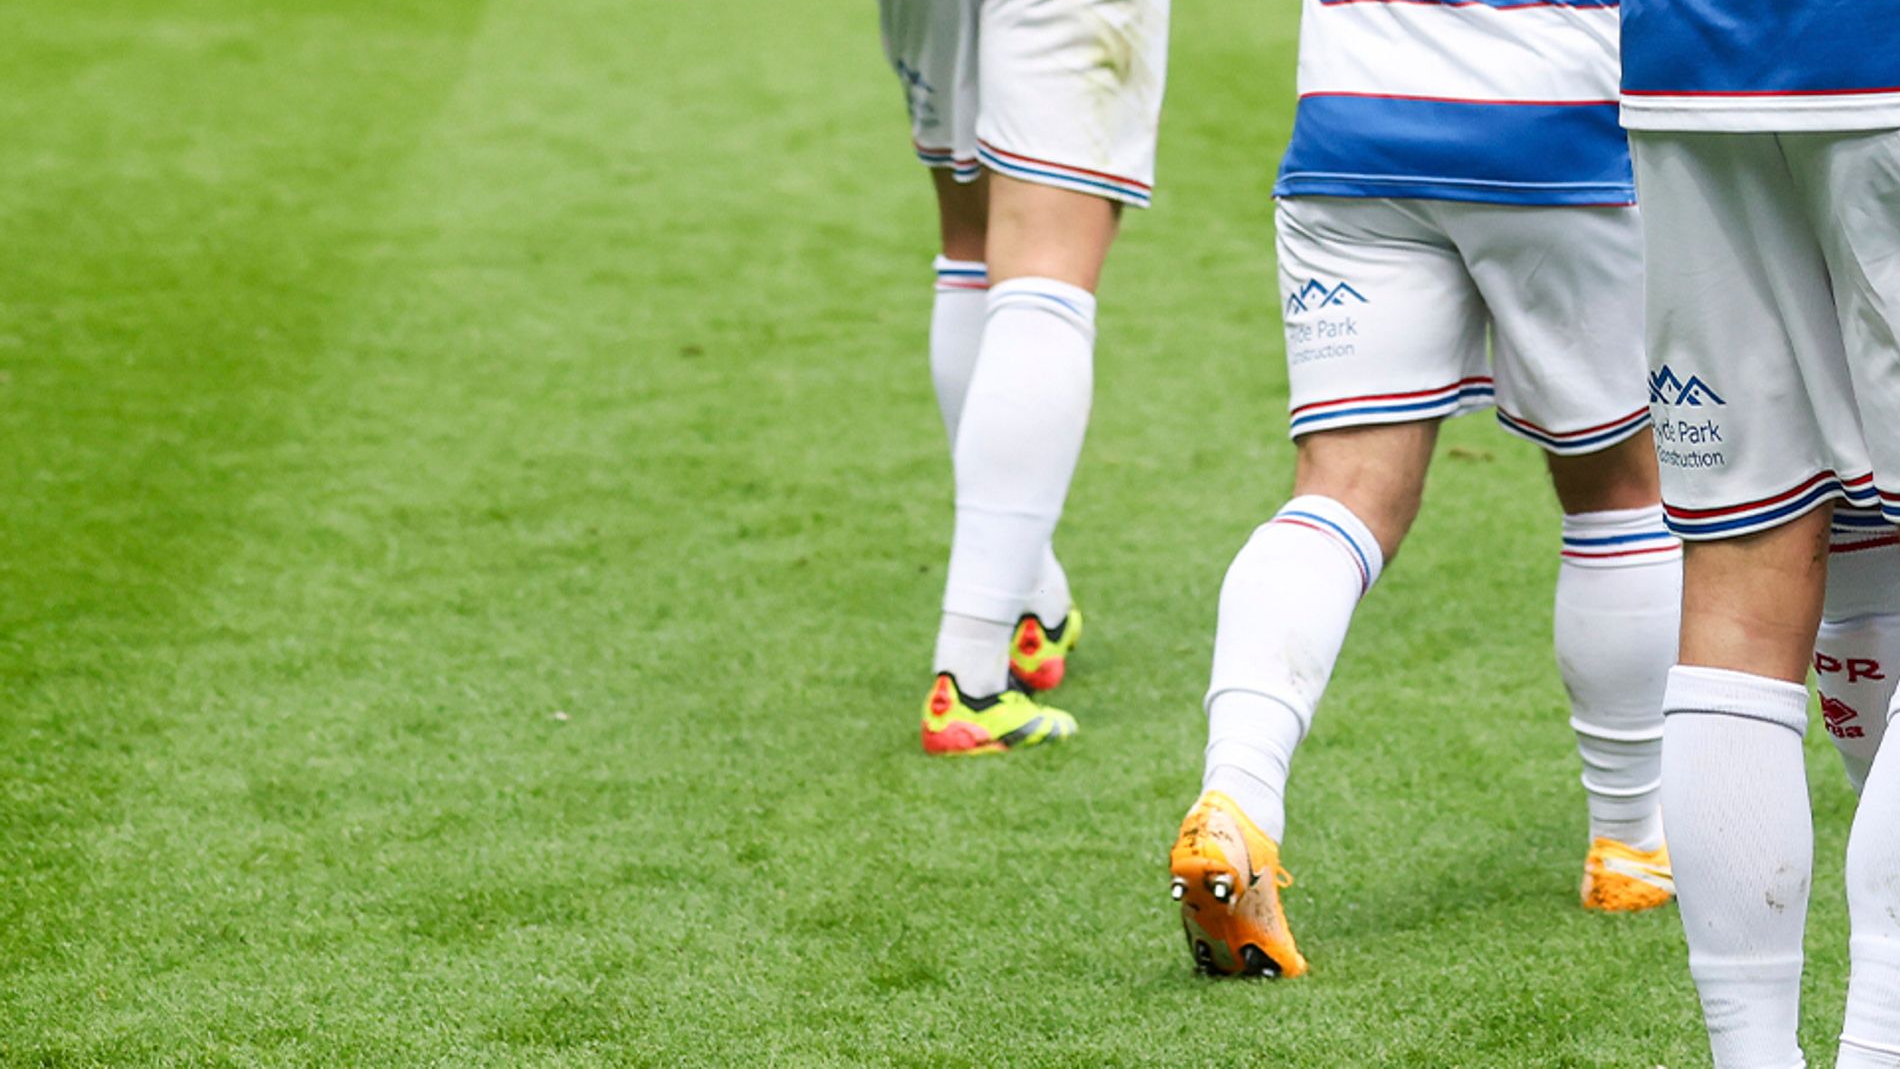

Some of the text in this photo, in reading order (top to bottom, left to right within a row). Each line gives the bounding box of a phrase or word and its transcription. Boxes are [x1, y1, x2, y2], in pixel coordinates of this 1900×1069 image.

[1318, 317, 1358, 338] Park
[1679, 419, 1722, 444] Park
[1815, 651, 1886, 683] PR
